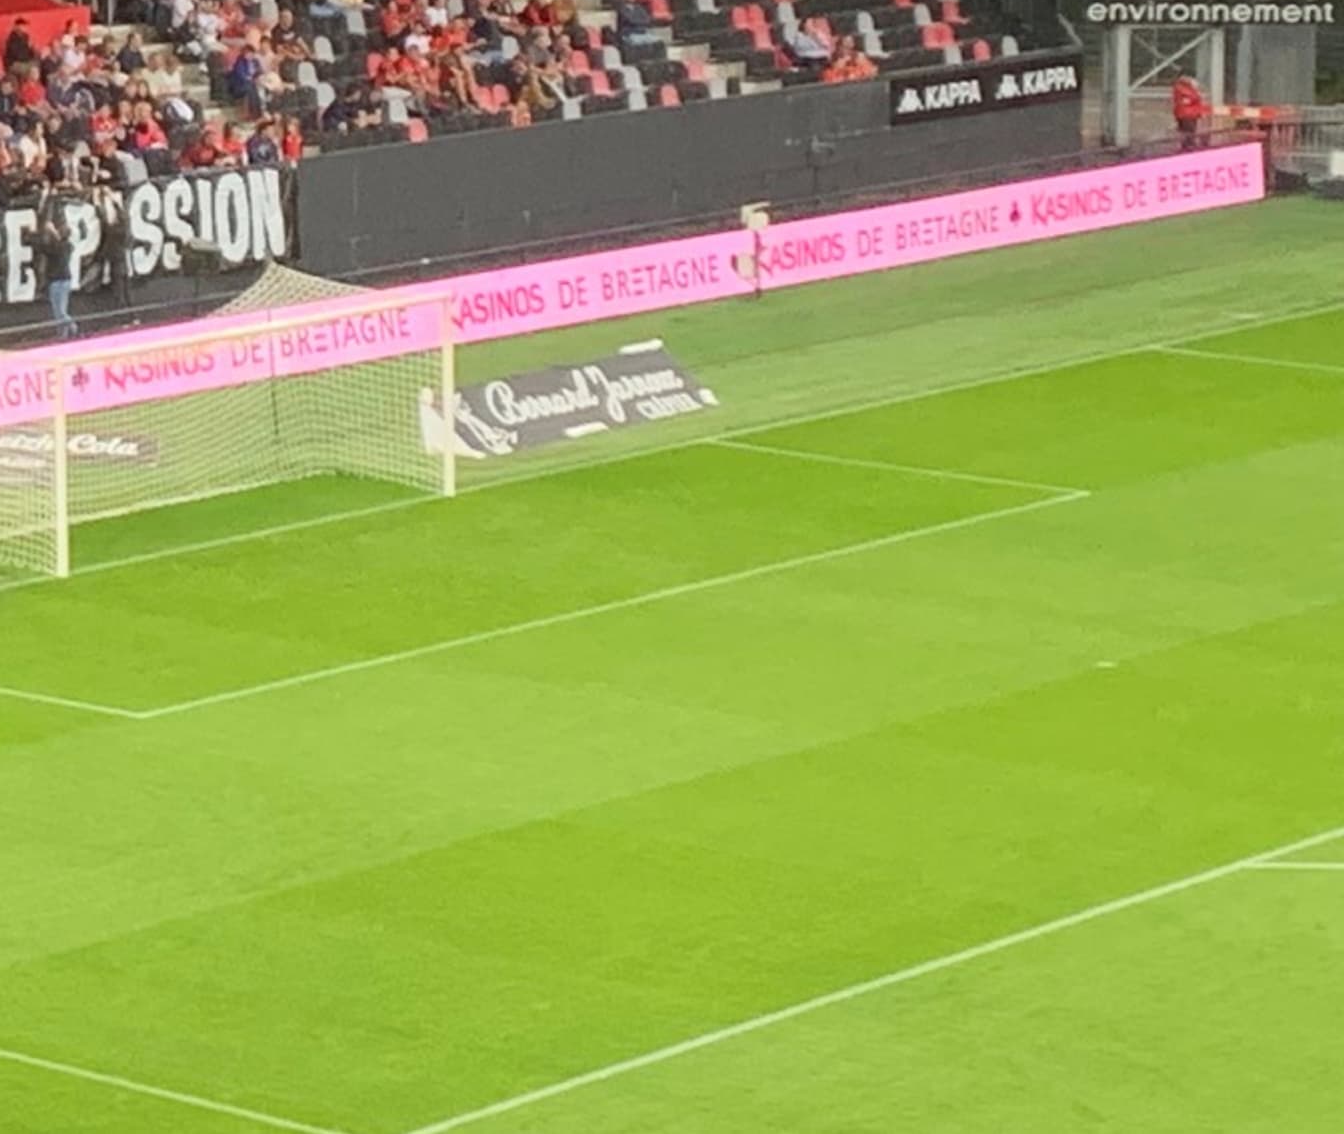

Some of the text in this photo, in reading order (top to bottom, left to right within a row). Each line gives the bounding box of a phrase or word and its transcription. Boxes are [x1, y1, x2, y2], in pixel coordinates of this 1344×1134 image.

[1088, 1, 1334, 24] environnement
[924, 79, 982, 110] KAPPA
[1022, 67, 1076, 97] KAPPA
[1030, 162, 1250, 227] KASINOS DE BRETAGNE
[65, 168, 286, 292] PSSION
[857, 227, 884, 258] DE
[896, 205, 1000, 251] BRETAGNE
[559, 278, 588, 309] DE
[602, 254, 720, 302] BRETAGNE
[231, 334, 265, 367] DE
[280, 307, 411, 359] BRETAGNE
